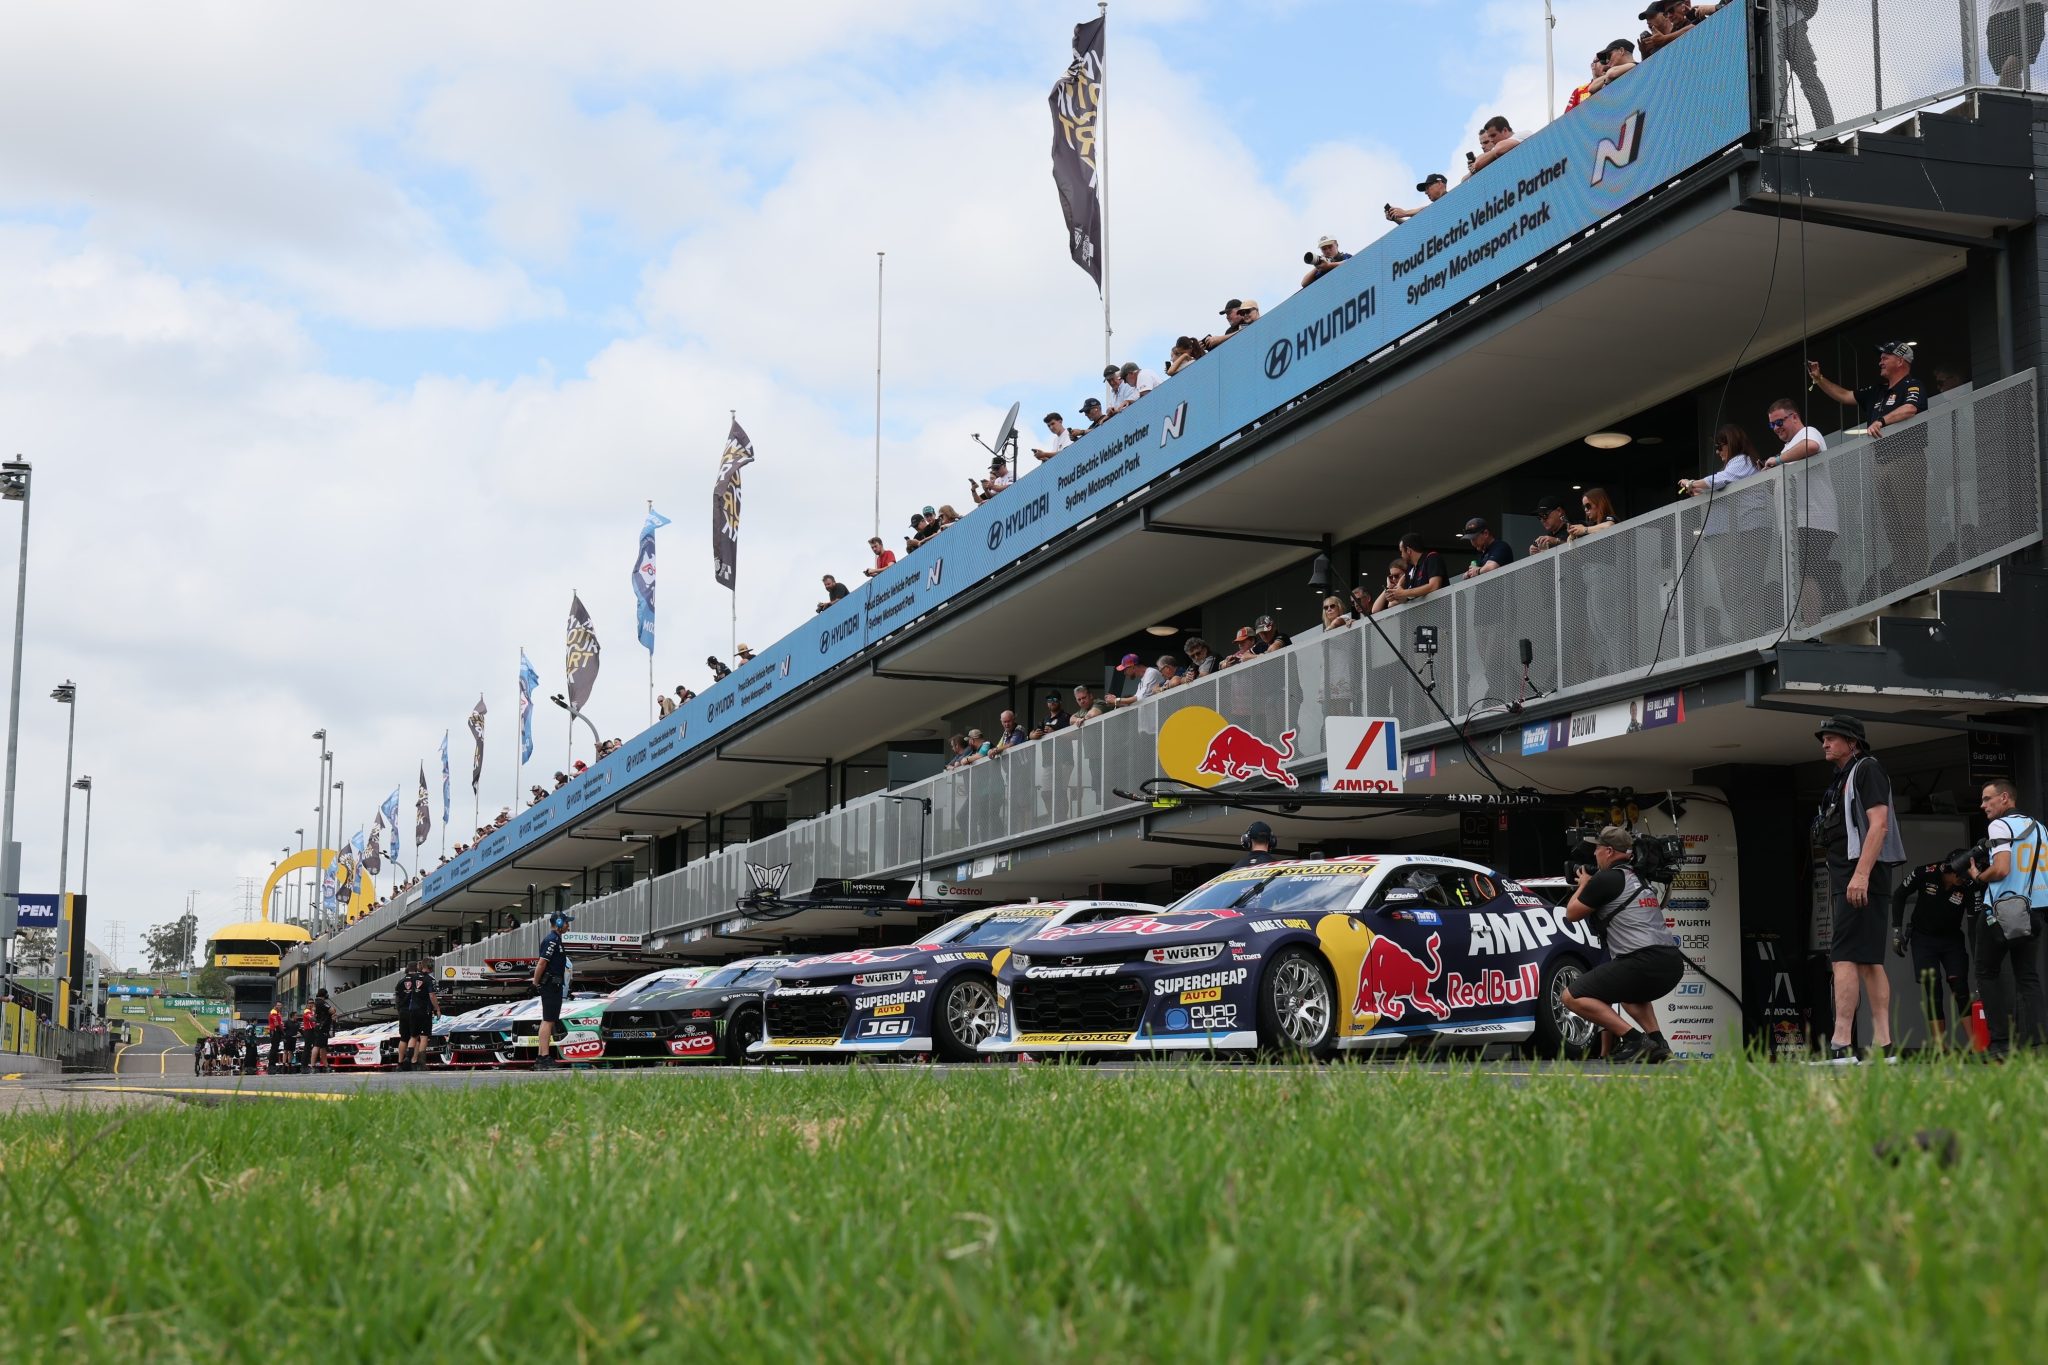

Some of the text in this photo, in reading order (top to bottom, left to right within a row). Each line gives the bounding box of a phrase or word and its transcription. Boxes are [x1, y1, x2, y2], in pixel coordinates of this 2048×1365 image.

[1392, 157, 1568, 281] Proud Electric Vehicle Partner
[1407, 202, 1551, 305] Sydney Motorsport Park
[1297, 286, 1376, 360] HYUNDAI
[1058, 424, 1149, 491] Proud Electric Vehicle Partner
[1066, 453, 1140, 511] Sydney Motorsport Park
[1005, 492, 1049, 538] HYUNDAI
[831, 613, 859, 645] HYUNDAI
[1557, 722, 1561, 741] 1
[1572, 711, 1596, 738] BROWN
[1524, 727, 1548, 745] Thrifty
[1333, 779, 1398, 792] AMPOL
[1284, 865, 1369, 875] STORAGE
[950, 887, 983, 896] Castrol
[1249, 919, 1311, 933] MAKE IT SUPER
[1229, 940, 1246, 948] Shaw
[933, 953, 957, 963] MAKE
[963, 952, 988, 960] SUPER
[1167, 945, 1216, 960] WÜRTH
[1232, 952, 1261, 960] Partners
[865, 971, 902, 982] WÜRTH
[1154, 968, 1248, 996] SUPERCHEAP
[1447, 962, 1539, 1009] Red Bull
[1678, 985, 1703, 994] JGI
[855, 990, 926, 1010] SUPERCHEAP
[1184, 990, 1217, 1000] AUTO
[692, 1008, 710, 1017] dba
[877, 1005, 902, 1014] AUTO
[1190, 1004, 1238, 1018] QUAD
[862, 1020, 910, 1036] JGI
[1190, 1016, 1238, 1029] LOCK
[672, 1036, 713, 1051] RYCO
[1064, 1033, 1128, 1042] STORAGE
[563, 1042, 599, 1054] RYCO
